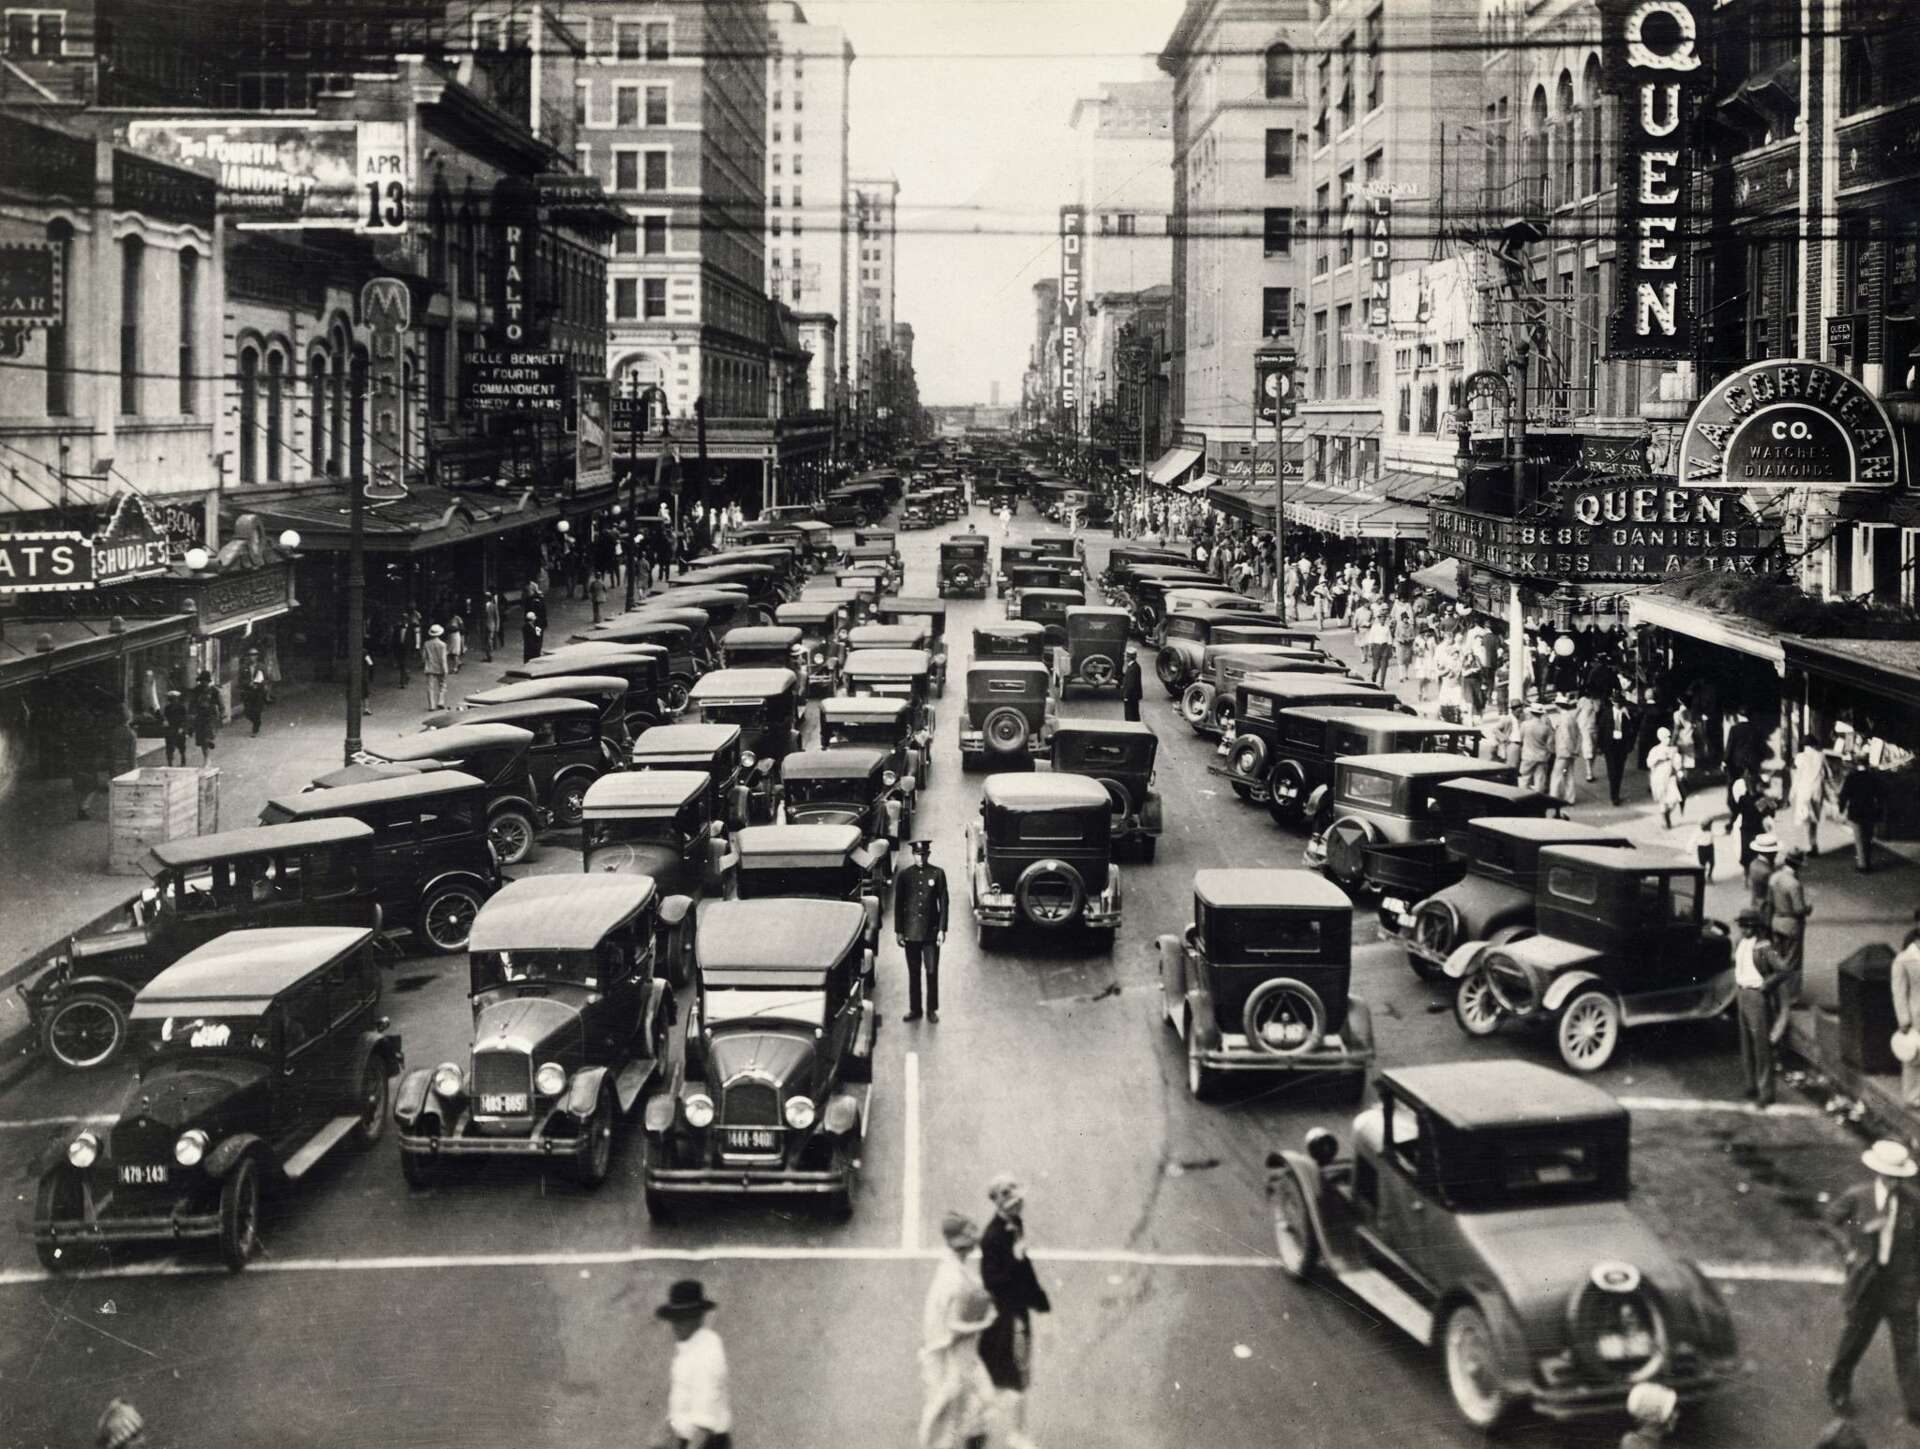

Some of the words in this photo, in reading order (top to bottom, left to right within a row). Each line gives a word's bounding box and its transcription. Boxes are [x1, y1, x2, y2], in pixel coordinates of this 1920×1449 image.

[206, 135, 277, 165] FOURTH
[366, 155, 401, 173] APR
[1623, 1, 1701, 336] QUEEN
[221, 164, 316, 194] ANDMENT
[365, 181, 405, 228] 13
[1063, 213, 1080, 316] FOLEY
[506, 226, 523, 340] RIALTO
[464, 353, 502, 364] BELLE
[510, 353, 565, 365] BENNETT
[493, 368, 540, 380] FOURTH
[472, 383, 556, 395] COMMANDMENT
[464, 398, 511, 409] COMEDY
[1771, 421, 1813, 440] CO.
[1750, 446, 1830, 460] WATCHES
[1745, 464, 1833, 478] DIAMONDS
[1573, 486, 1725, 526] QUEEN
[1521, 527, 1592, 546] BEBE
[1612, 528, 1737, 547] DANIELS
[97, 542, 167, 575] SHUDDE'S
[1521, 552, 1590, 573] KISS
[1616, 554, 1645, 573] IN
[1665, 553, 1682, 573] A
[1706, 555, 1770, 575] TAXI
